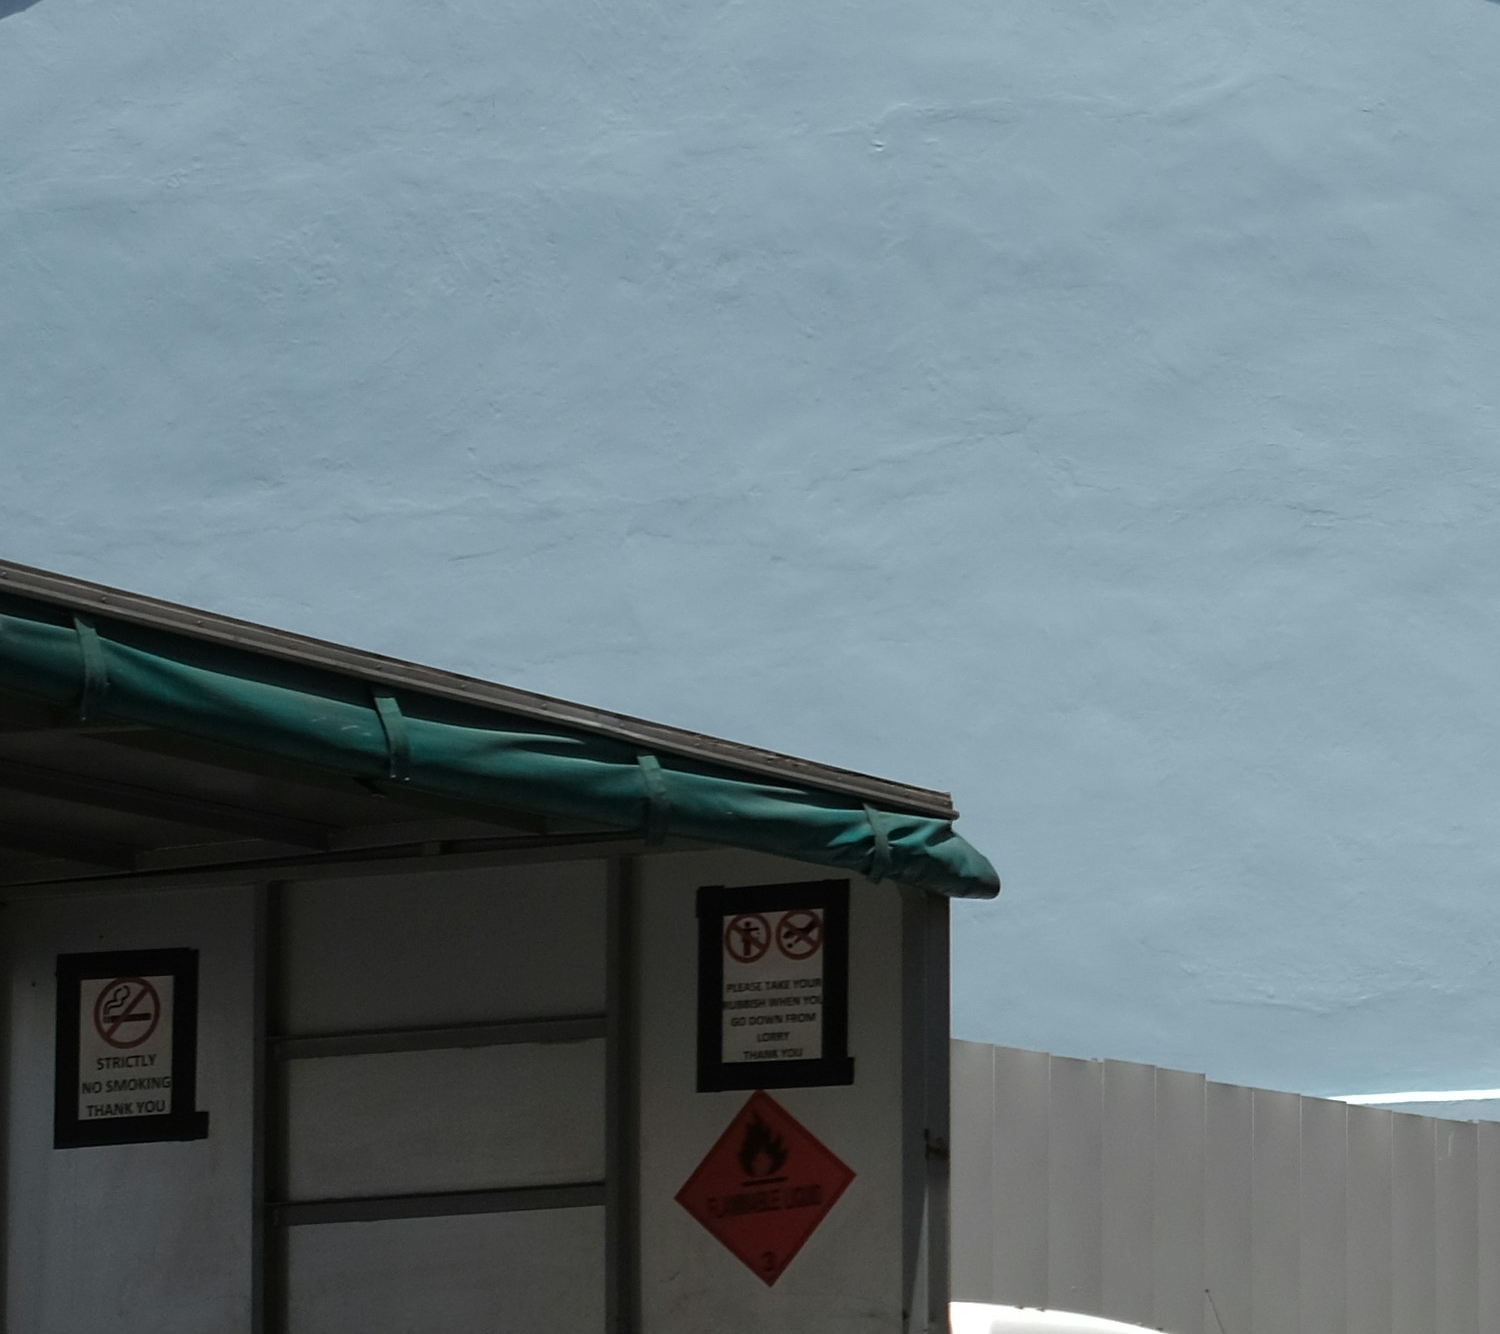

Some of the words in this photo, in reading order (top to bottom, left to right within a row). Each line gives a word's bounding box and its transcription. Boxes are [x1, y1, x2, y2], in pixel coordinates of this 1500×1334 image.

[727, 982, 763, 993] PLEASE
[749, 1015, 783, 1026] DOWN
[786, 1012, 817, 1023] FROM
[757, 1031, 790, 1043] LORRY
[97, 1054, 157, 1071] STRICTLY
[82, 1081, 102, 1095] NO
[106, 1076, 172, 1093] SMOKING
[87, 1102, 134, 1117] THANK
[137, 1100, 166, 1113] YOU
